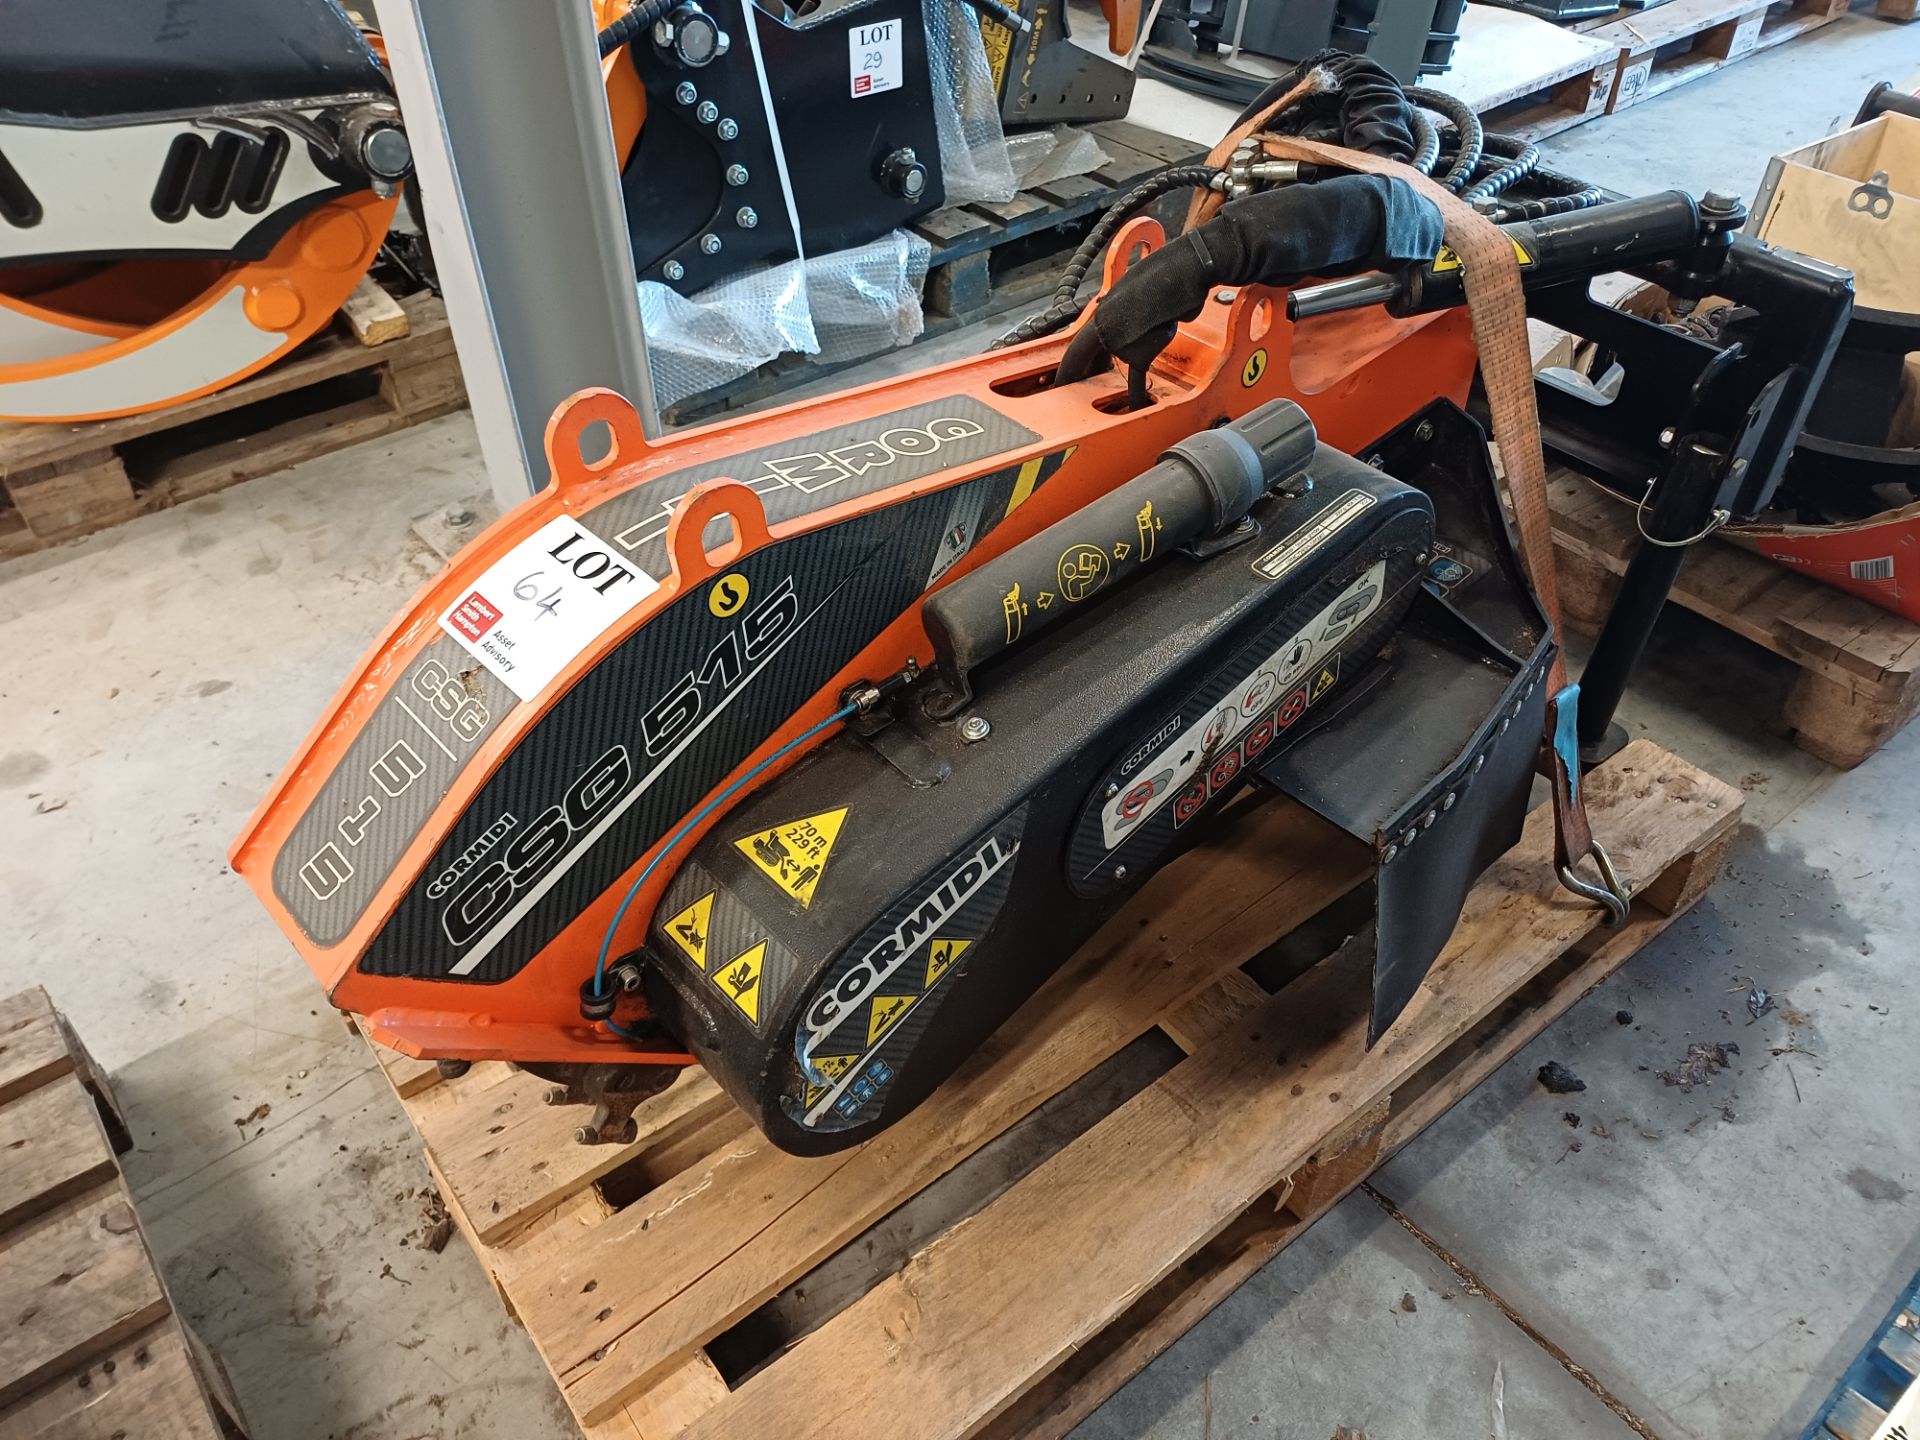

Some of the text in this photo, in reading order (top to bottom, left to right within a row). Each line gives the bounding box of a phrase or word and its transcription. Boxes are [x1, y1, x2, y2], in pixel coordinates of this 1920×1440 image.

[860, 24, 893, 46] LOT
[863, 51, 883, 71] 29
[547, 532, 636, 596] LOT
[931, 547, 966, 580] MADE IN ITALY
[513, 571, 563, 621] 64
[1358, 574, 1370, 590] OK
[452, 611, 481, 637] Hampton
[461, 604, 480, 622] Smith
[468, 596, 496, 621] Lambert
[481, 640, 516, 673] Advisory
[493, 630, 516, 650] Asset
[640, 575, 799, 757] 515
[412, 659, 490, 742] CSG
[1121, 714, 1180, 775] CORMIDI
[442, 744, 632, 946] CSG
[785, 827, 820, 860] 229 ft
[800, 822, 827, 848] 70 m
[426, 812, 518, 899] CORMIDI
[807, 837, 1003, 1030] CORMIDI
